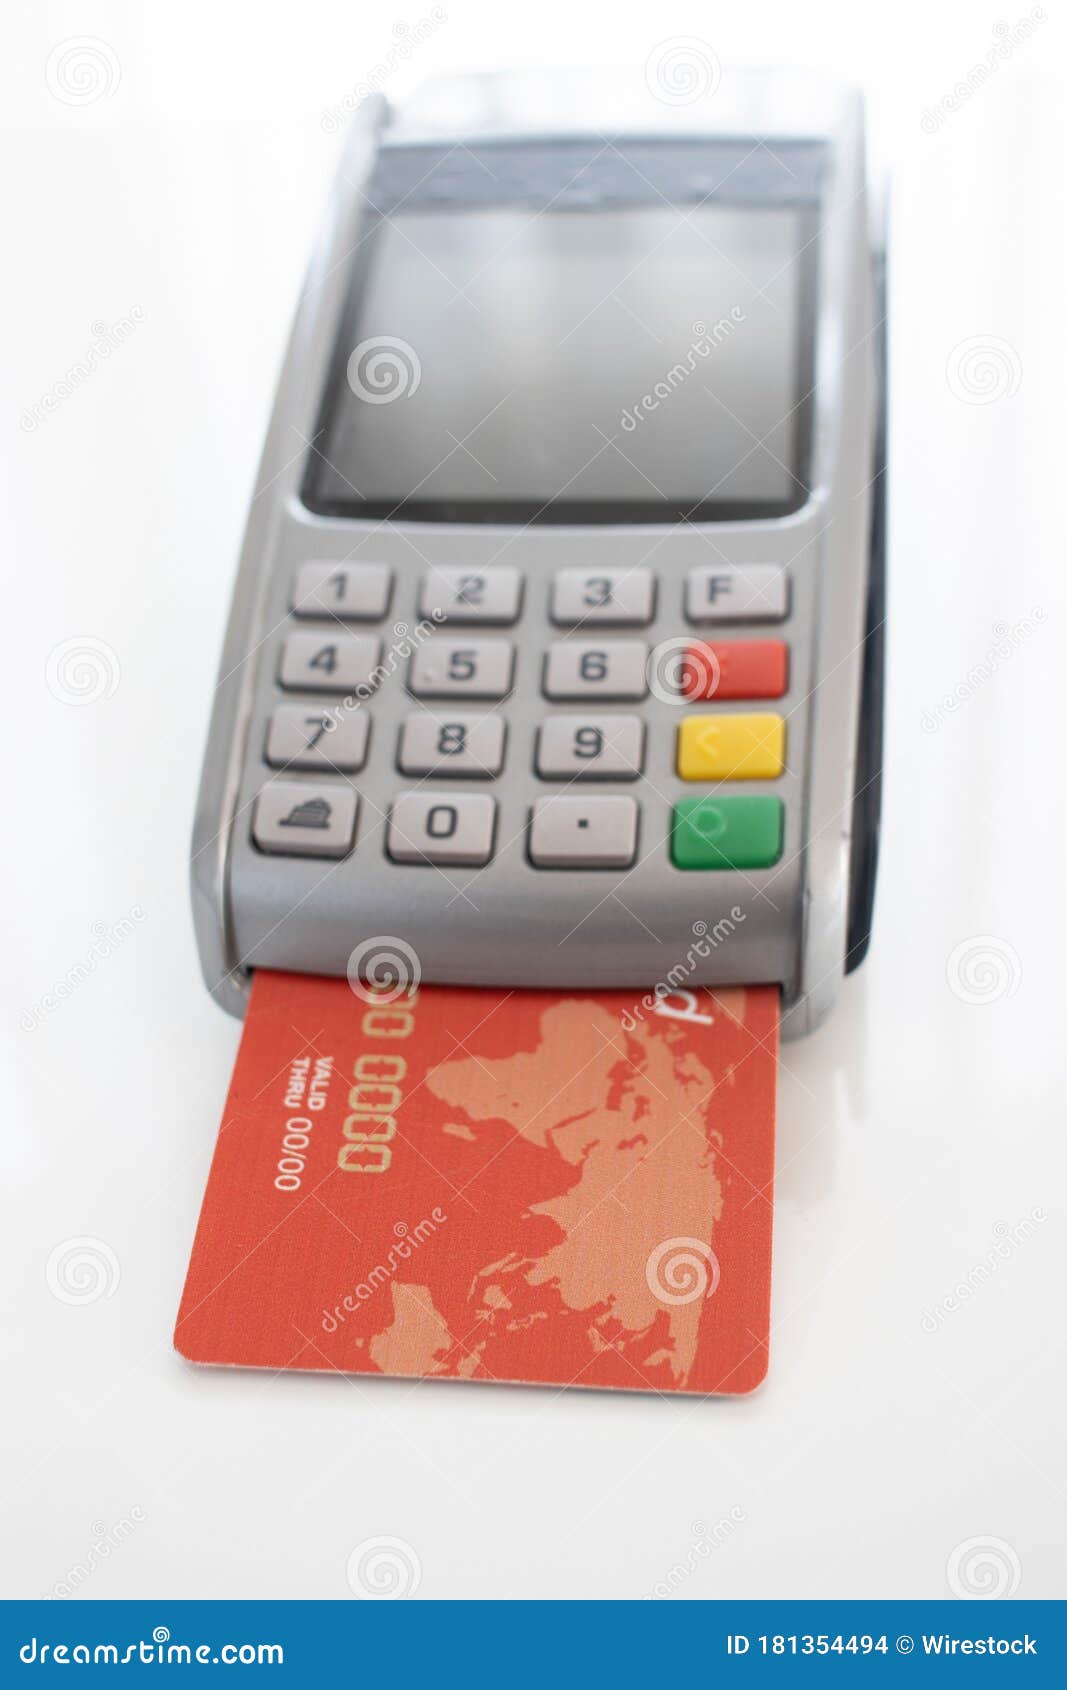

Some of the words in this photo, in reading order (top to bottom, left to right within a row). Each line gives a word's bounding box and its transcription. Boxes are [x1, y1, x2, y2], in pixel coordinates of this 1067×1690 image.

[328, 573, 347, 600] 1
[456, 576, 486, 604] 2
[583, 577, 612, 606] 3
[708, 575, 732, 604] F
[309, 645, 338, 674] 4
[448, 650, 477, 681] 5
[579, 651, 608, 682] 6
[305, 717, 332, 749] 7
[437, 723, 467, 755] 8
[574, 727, 604, 759] 9
[426, 805, 458, 838] 0
[284, 1057, 311, 1108] THRU
[307, 1056, 334, 1111] VALID
[338, 1054, 407, 1172] 0000
[274, 1117, 312, 1191] 00/00
